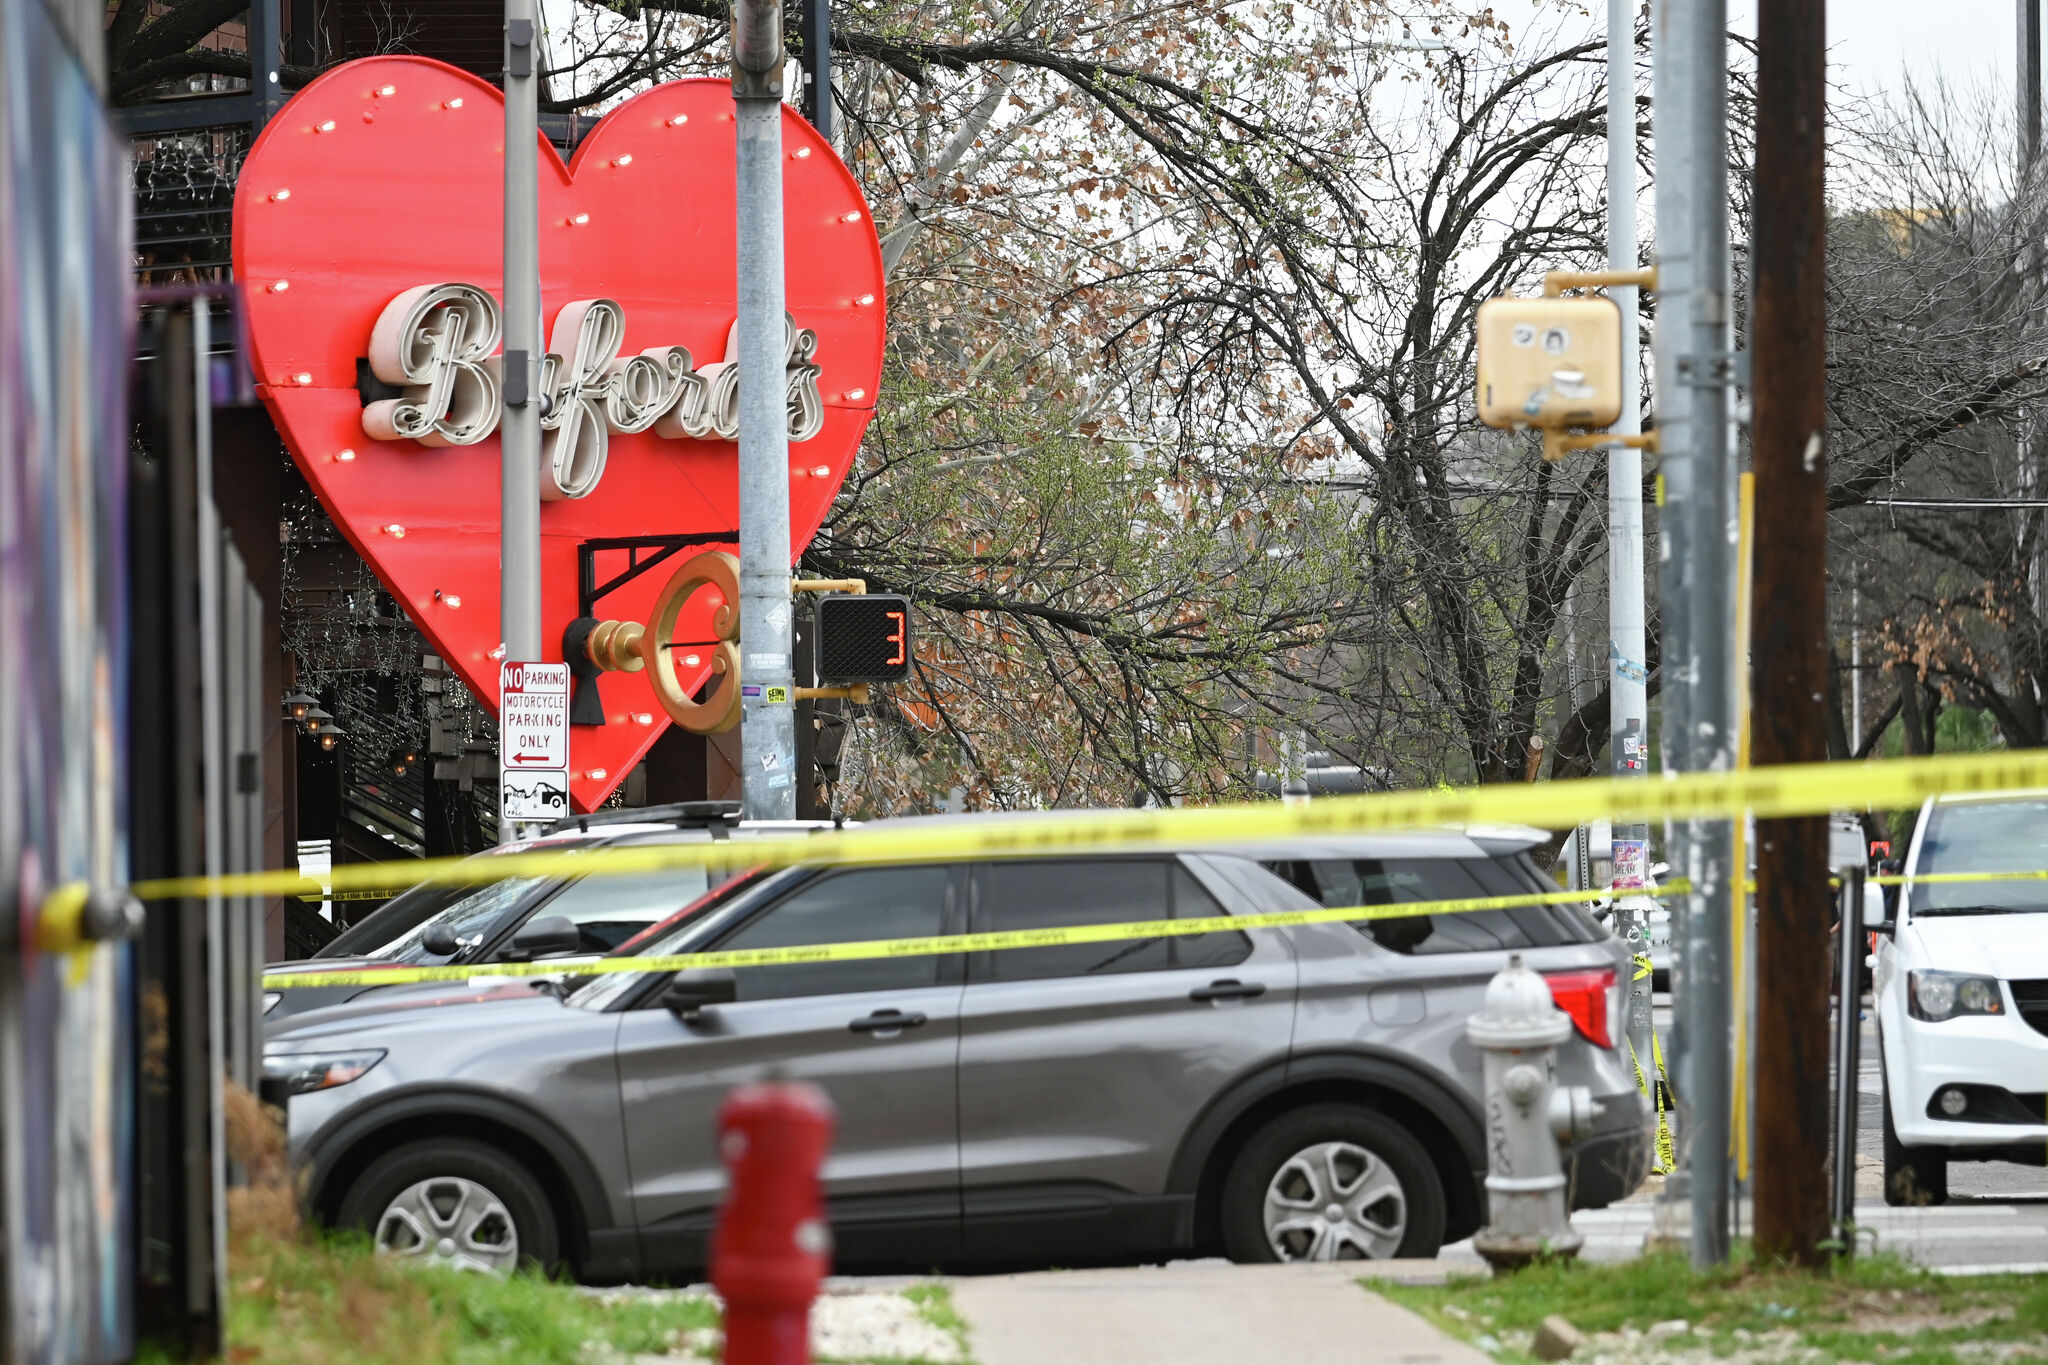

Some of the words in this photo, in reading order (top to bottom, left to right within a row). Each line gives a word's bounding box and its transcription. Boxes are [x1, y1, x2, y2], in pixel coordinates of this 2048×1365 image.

[886, 611, 906, 666] 3
[504, 667, 523, 689] NO
[525, 671, 565, 686] PARKING
[506, 695, 564, 709] MOTORCYCLE
[508, 713, 562, 727] PARKING
[519, 734, 551, 748] ONLY
